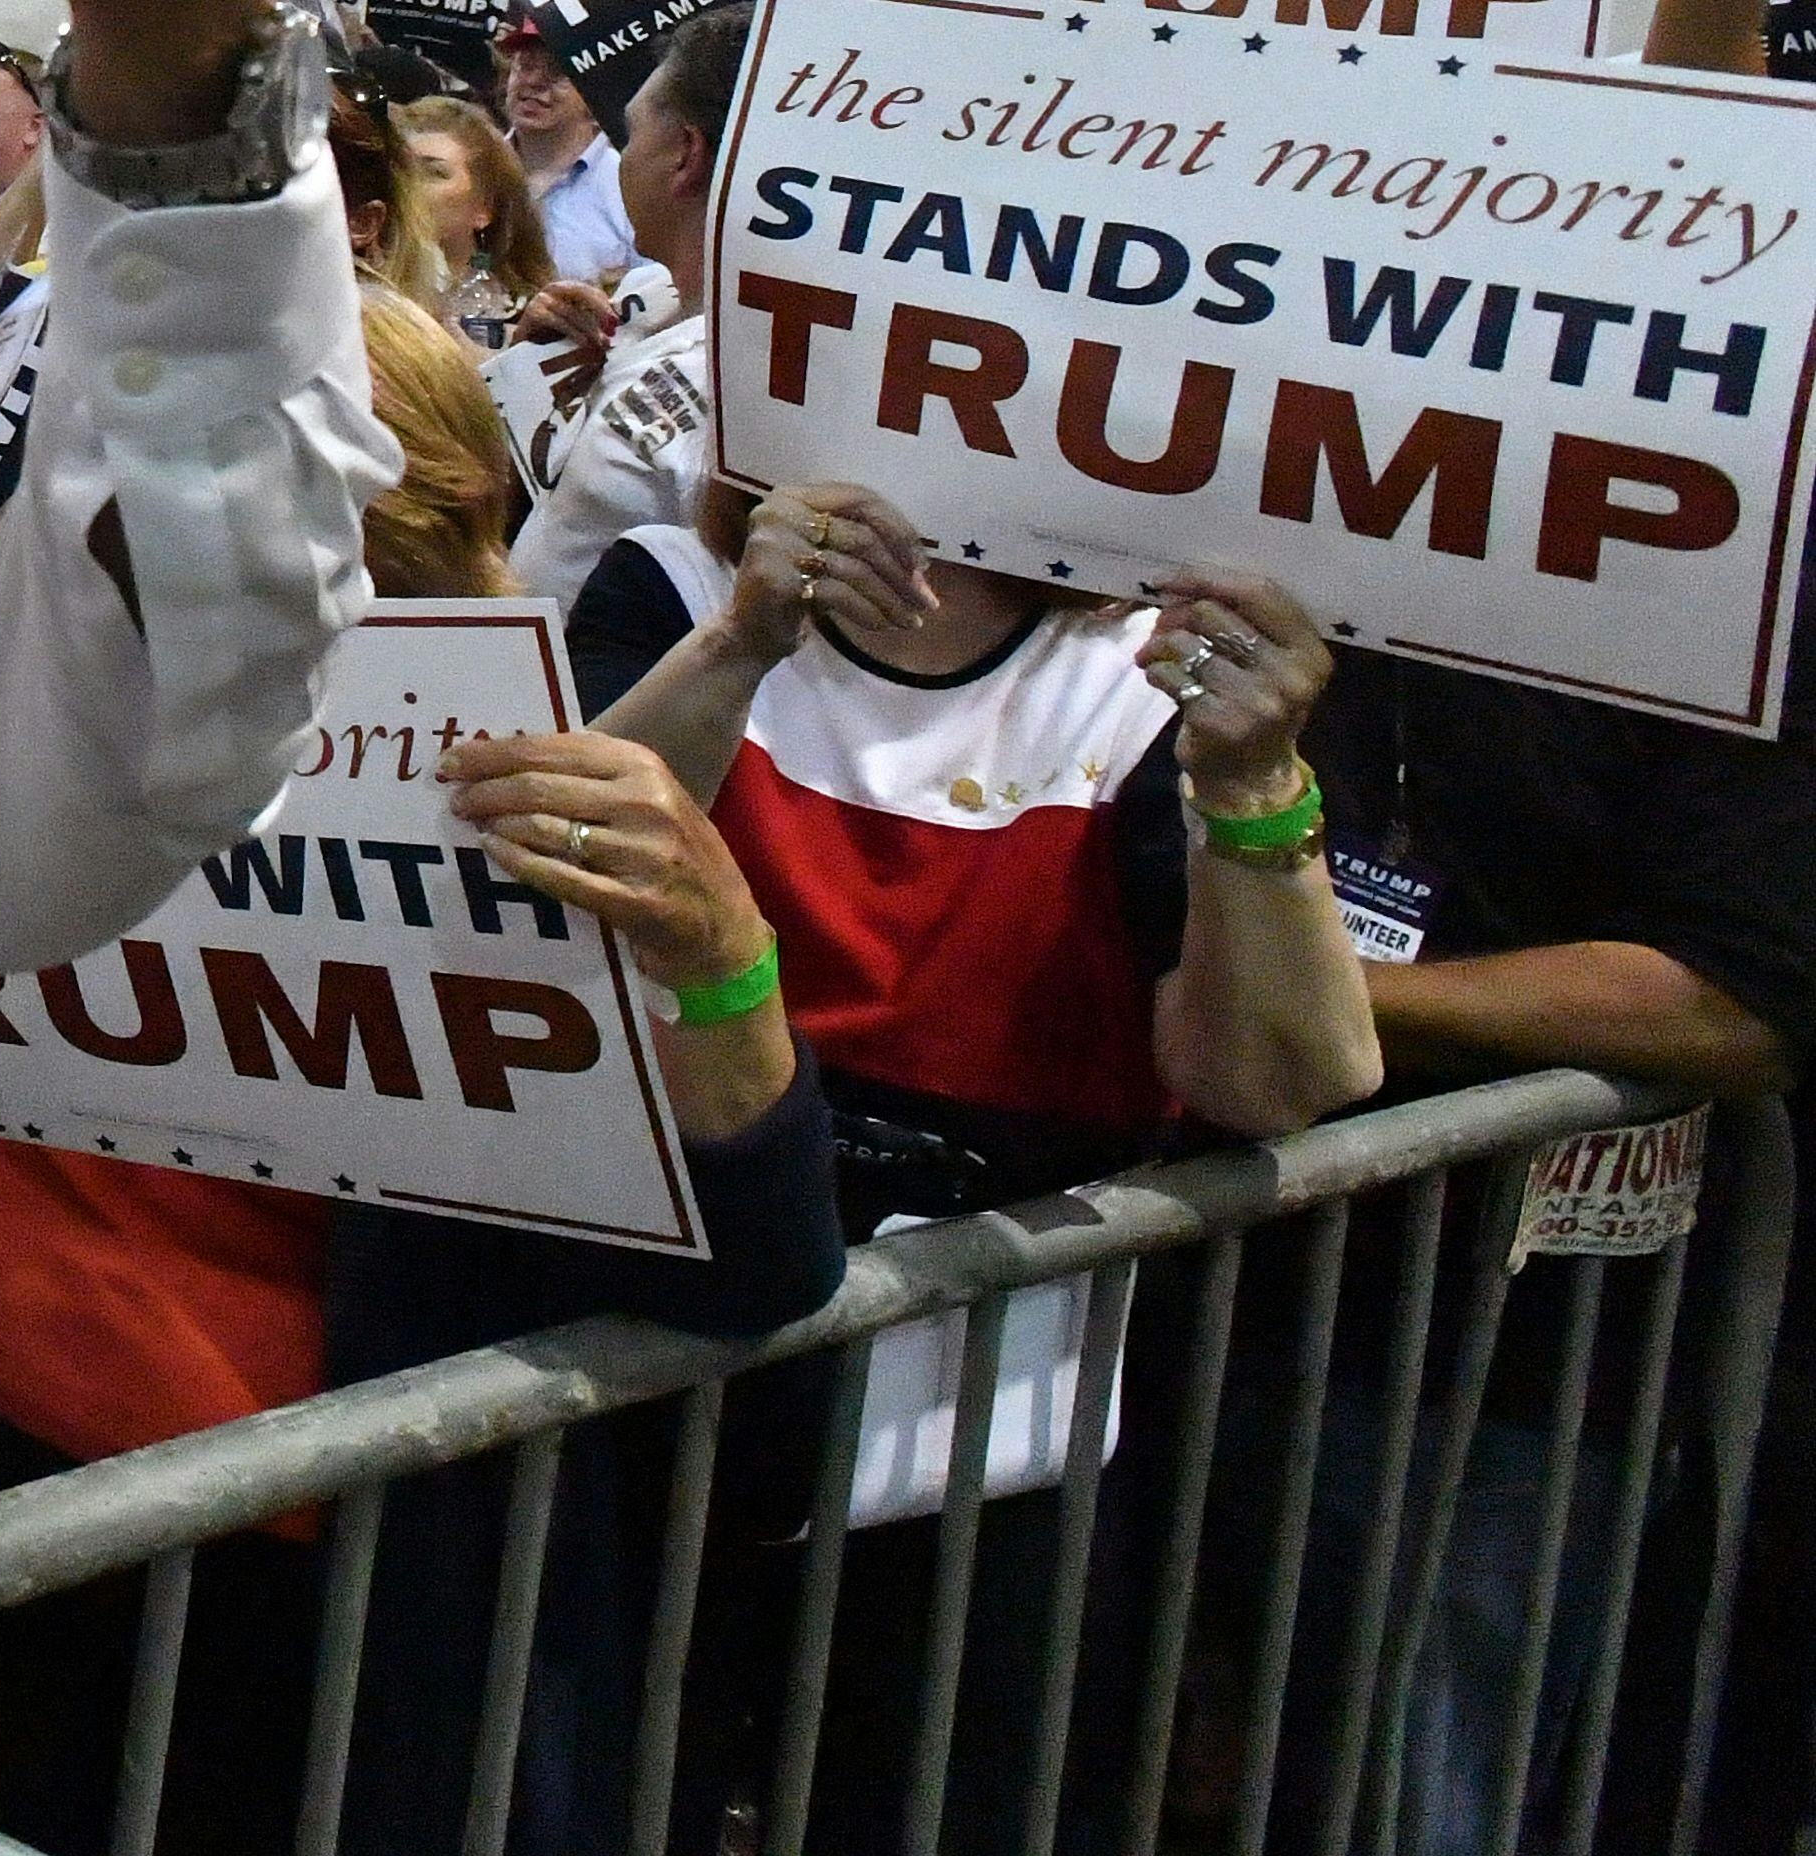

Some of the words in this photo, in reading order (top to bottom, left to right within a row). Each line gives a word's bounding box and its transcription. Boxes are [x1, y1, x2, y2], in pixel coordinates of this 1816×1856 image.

[571, 19, 650, 75] MAKE
[774, 49, 924, 130] the
[940, 75, 1227, 175] silent
[1255, 134, 1799, 286] majority
[747, 166, 1282, 326] STANDS
[1322, 255, 1767, 417] WITH
[737, 270, 1742, 583] TRUMP
[200, 833, 571, 941] WITH
[1333, 850, 1432, 898] TRUMP
[1343, 910, 1411, 954] UNTEER
